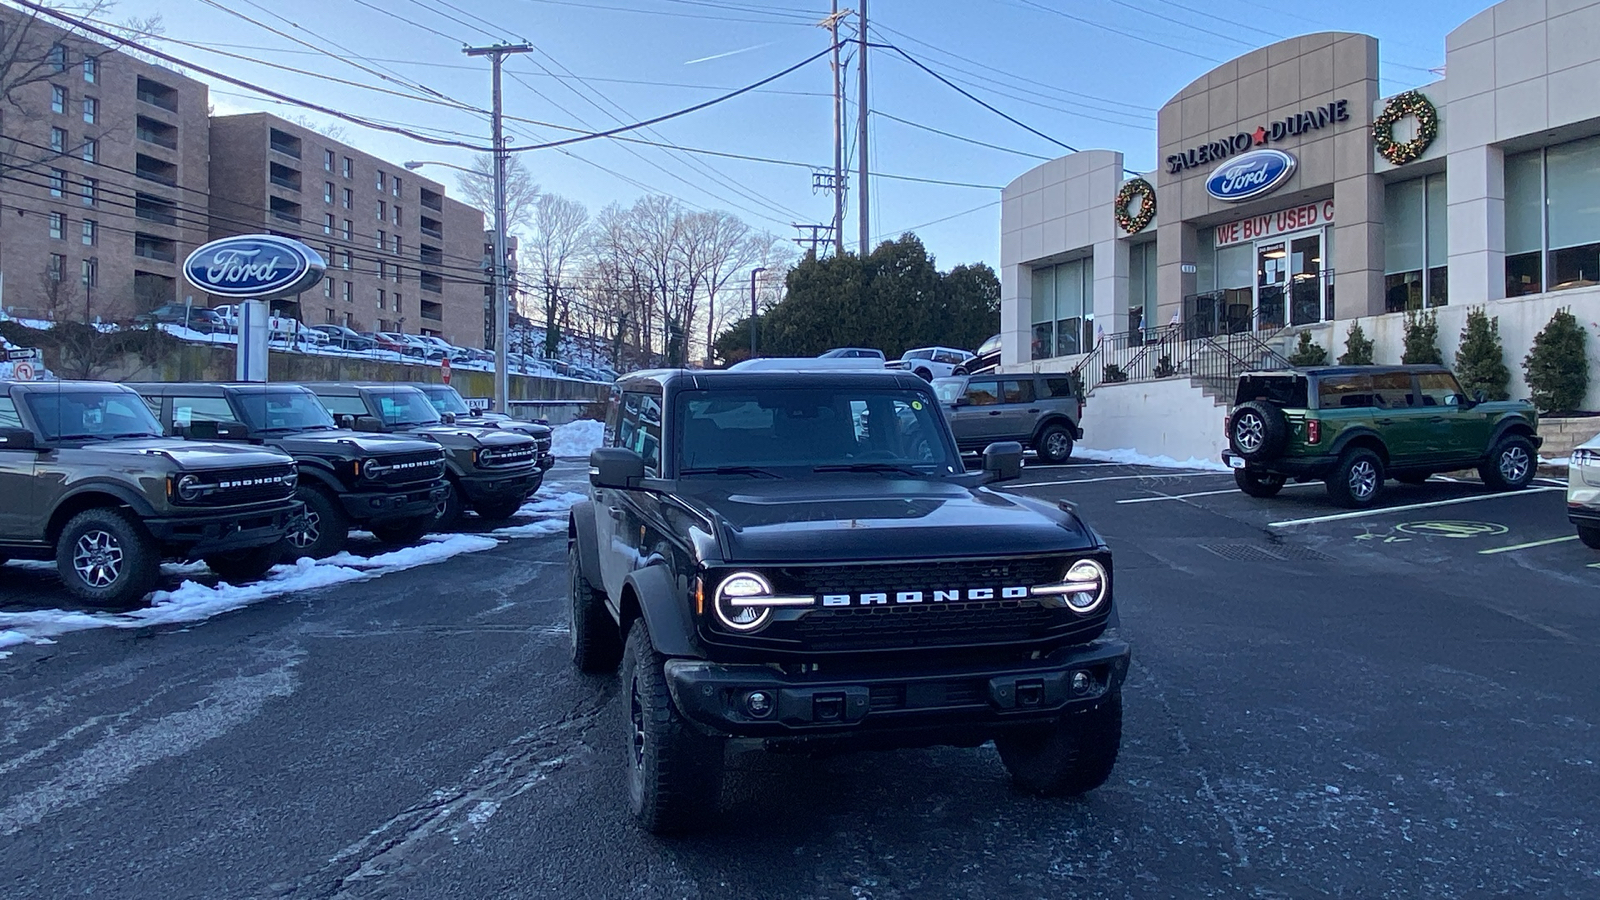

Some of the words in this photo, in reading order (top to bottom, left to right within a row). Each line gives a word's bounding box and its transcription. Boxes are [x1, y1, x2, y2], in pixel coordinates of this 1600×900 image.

[1166, 131, 1251, 174] SALERNO
[1270, 99, 1350, 142] DUANE
[1221, 161, 1269, 194] Ford
[1217, 222, 1239, 245] WE
[1243, 214, 1273, 240] BUY
[1276, 204, 1318, 232] USED
[207, 248, 280, 284] Ford
[470, 400, 485, 408] EXIT
[392, 460, 436, 470] BRONCO
[220, 476, 282, 488] BRONCO
[822, 586, 1028, 607] BRONCO
